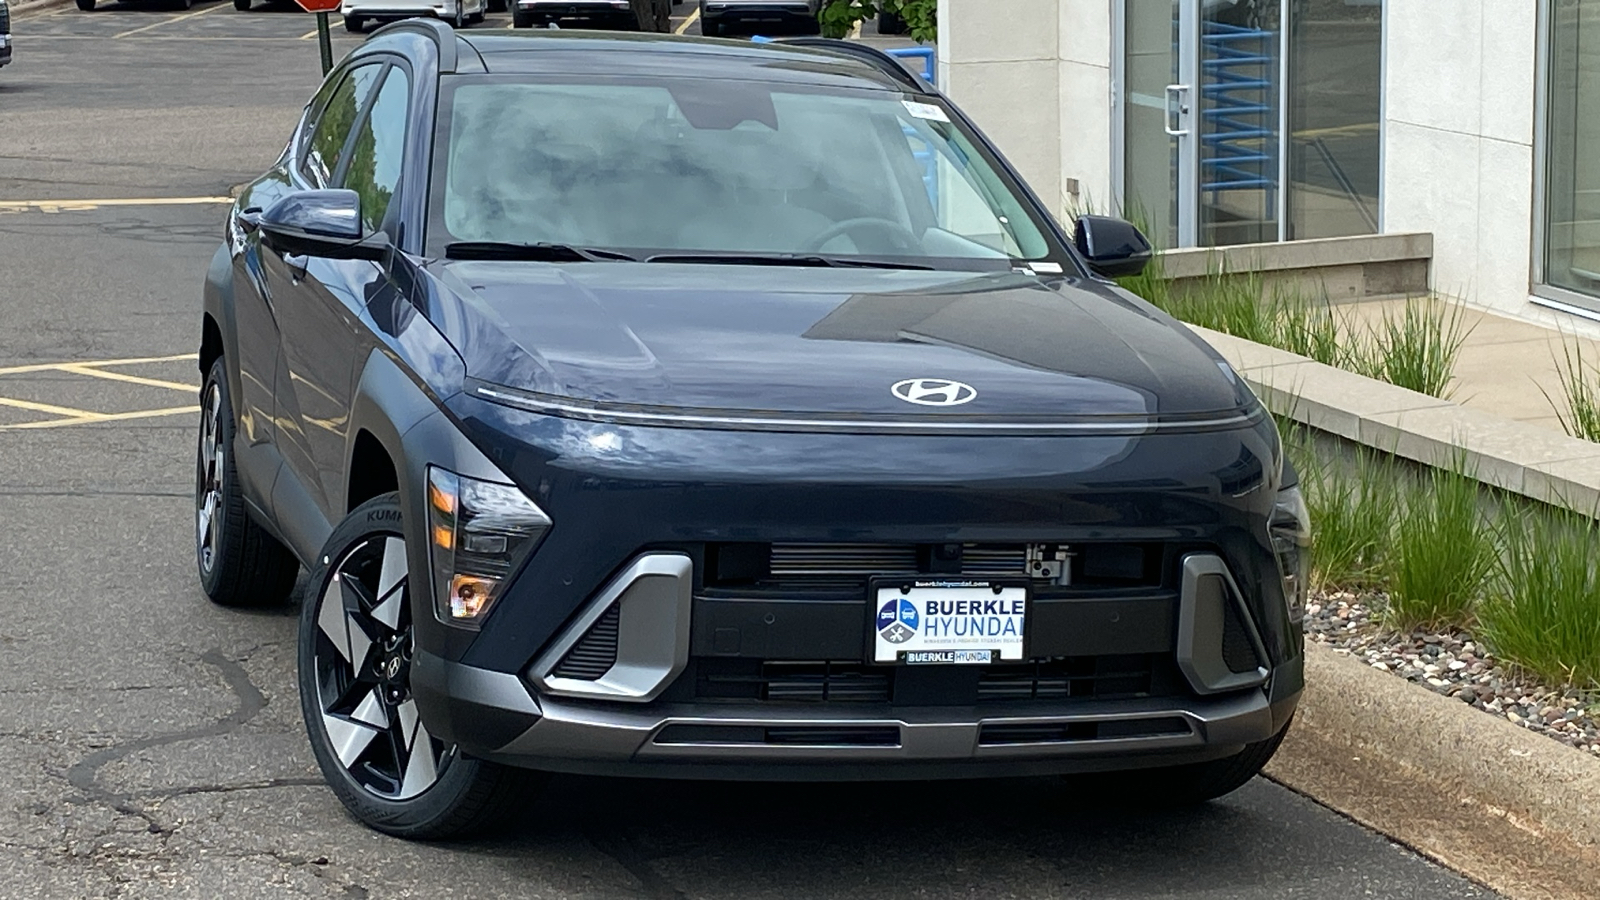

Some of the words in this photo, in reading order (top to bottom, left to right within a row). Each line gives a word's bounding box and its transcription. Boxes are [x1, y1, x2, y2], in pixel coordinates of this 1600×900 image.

[926, 600, 1024, 615] BUERKLE
[924, 616, 1024, 637] HYUNDAI
[908, 652, 954, 662] BUERKLE
[955, 652, 990, 662] HYUNDAI
